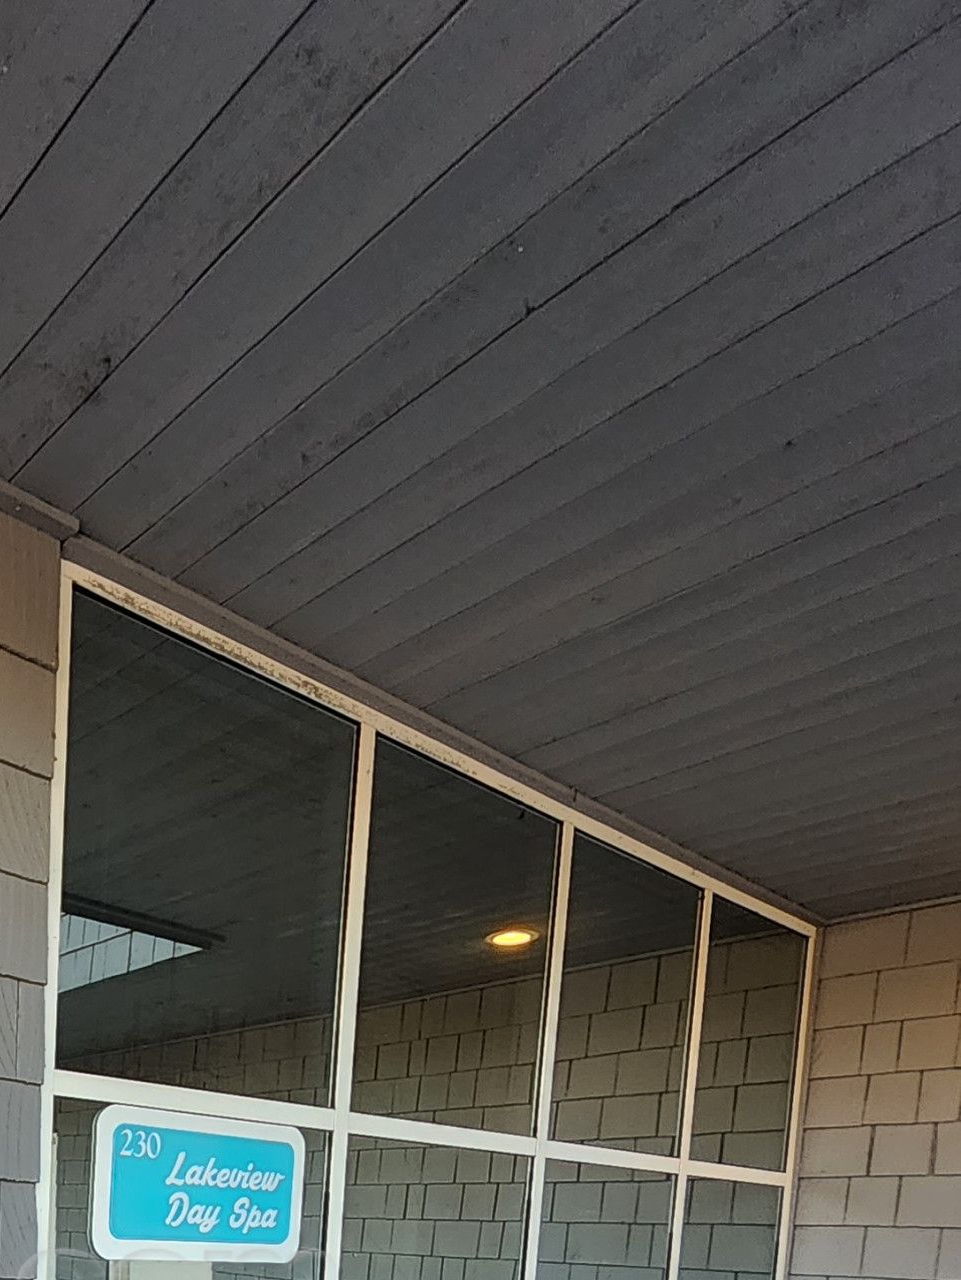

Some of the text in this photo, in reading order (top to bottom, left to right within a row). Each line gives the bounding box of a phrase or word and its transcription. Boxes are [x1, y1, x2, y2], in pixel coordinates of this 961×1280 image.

[119, 1128, 163, 1159] 230
[165, 1151, 286, 1192] Lakeview
[165, 1191, 279, 1235] Day Spa
